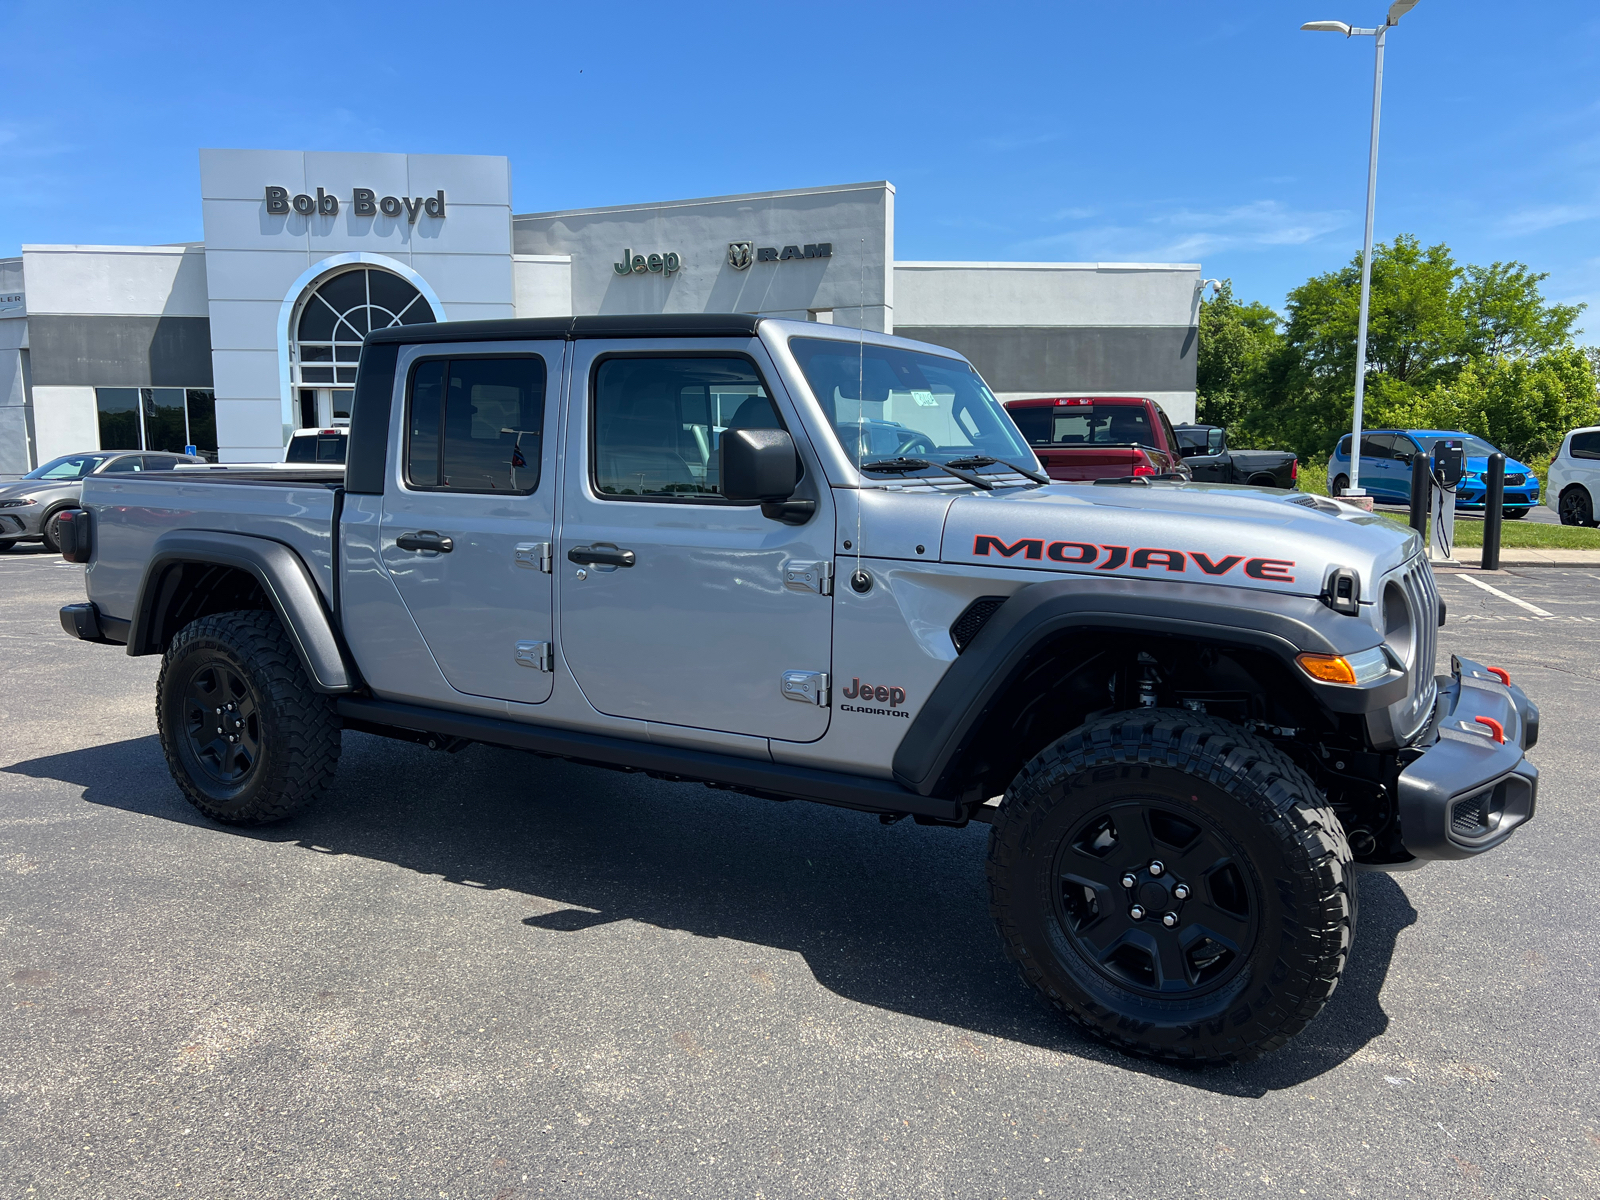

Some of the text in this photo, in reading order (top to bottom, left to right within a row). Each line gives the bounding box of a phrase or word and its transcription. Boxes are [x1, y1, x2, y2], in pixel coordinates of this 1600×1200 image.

[265, 186, 446, 224] Bob Boyd
[613, 248, 682, 277] Jeep
[757, 243, 833, 262] RAM
[973, 534, 1296, 583] MOJAVE
[843, 677, 906, 708] Jeep
[840, 704, 910, 719] GLADIATOR
